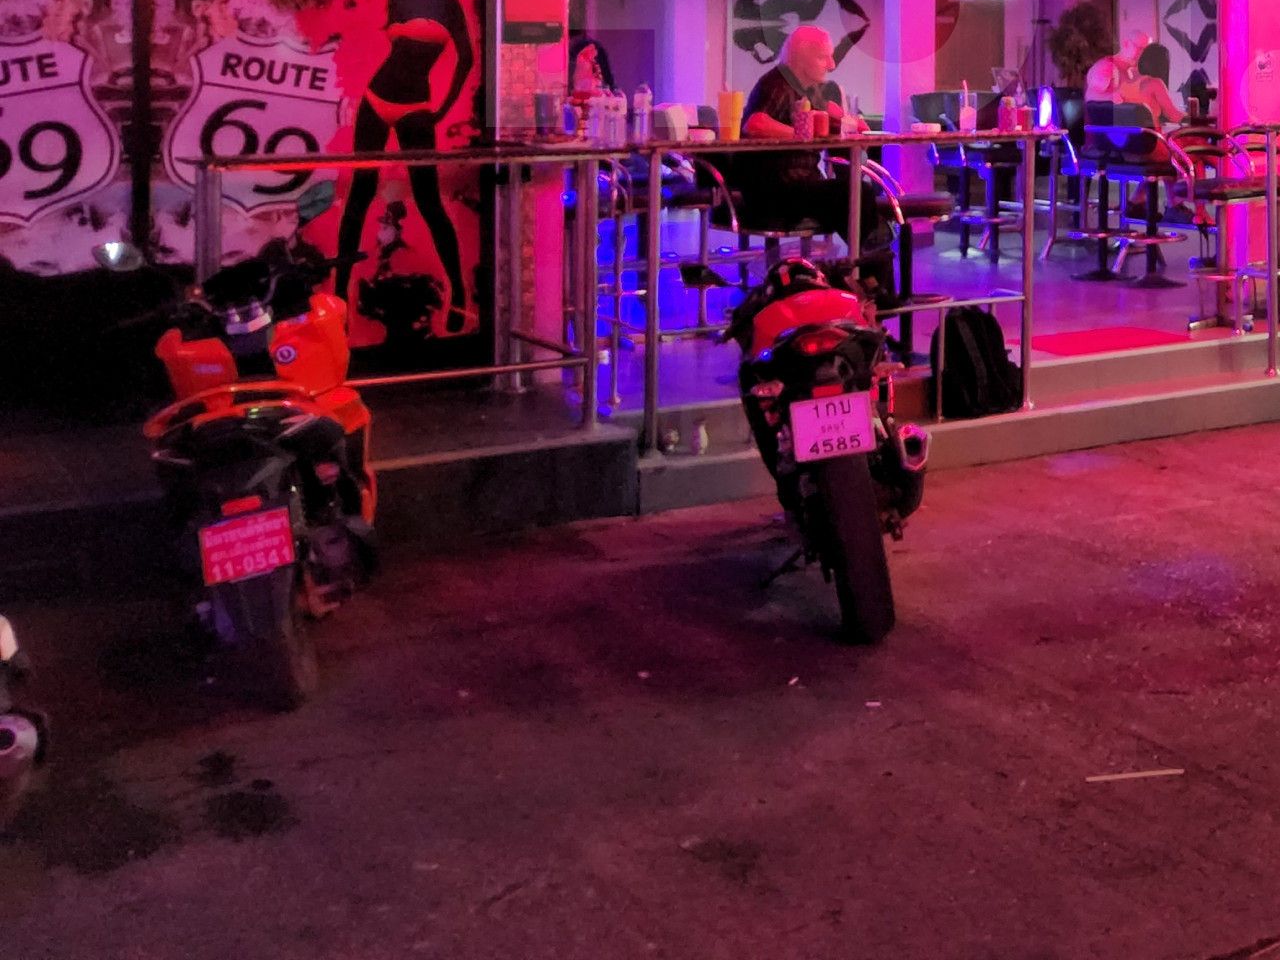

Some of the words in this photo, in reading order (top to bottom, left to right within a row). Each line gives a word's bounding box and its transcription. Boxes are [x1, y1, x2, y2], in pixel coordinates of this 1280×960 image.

[220, 51, 330, 92] ROUTE
[199, 98, 321, 195] 69
[809, 433, 862, 455] 4585
[211, 545, 292, 582] 11-0541
